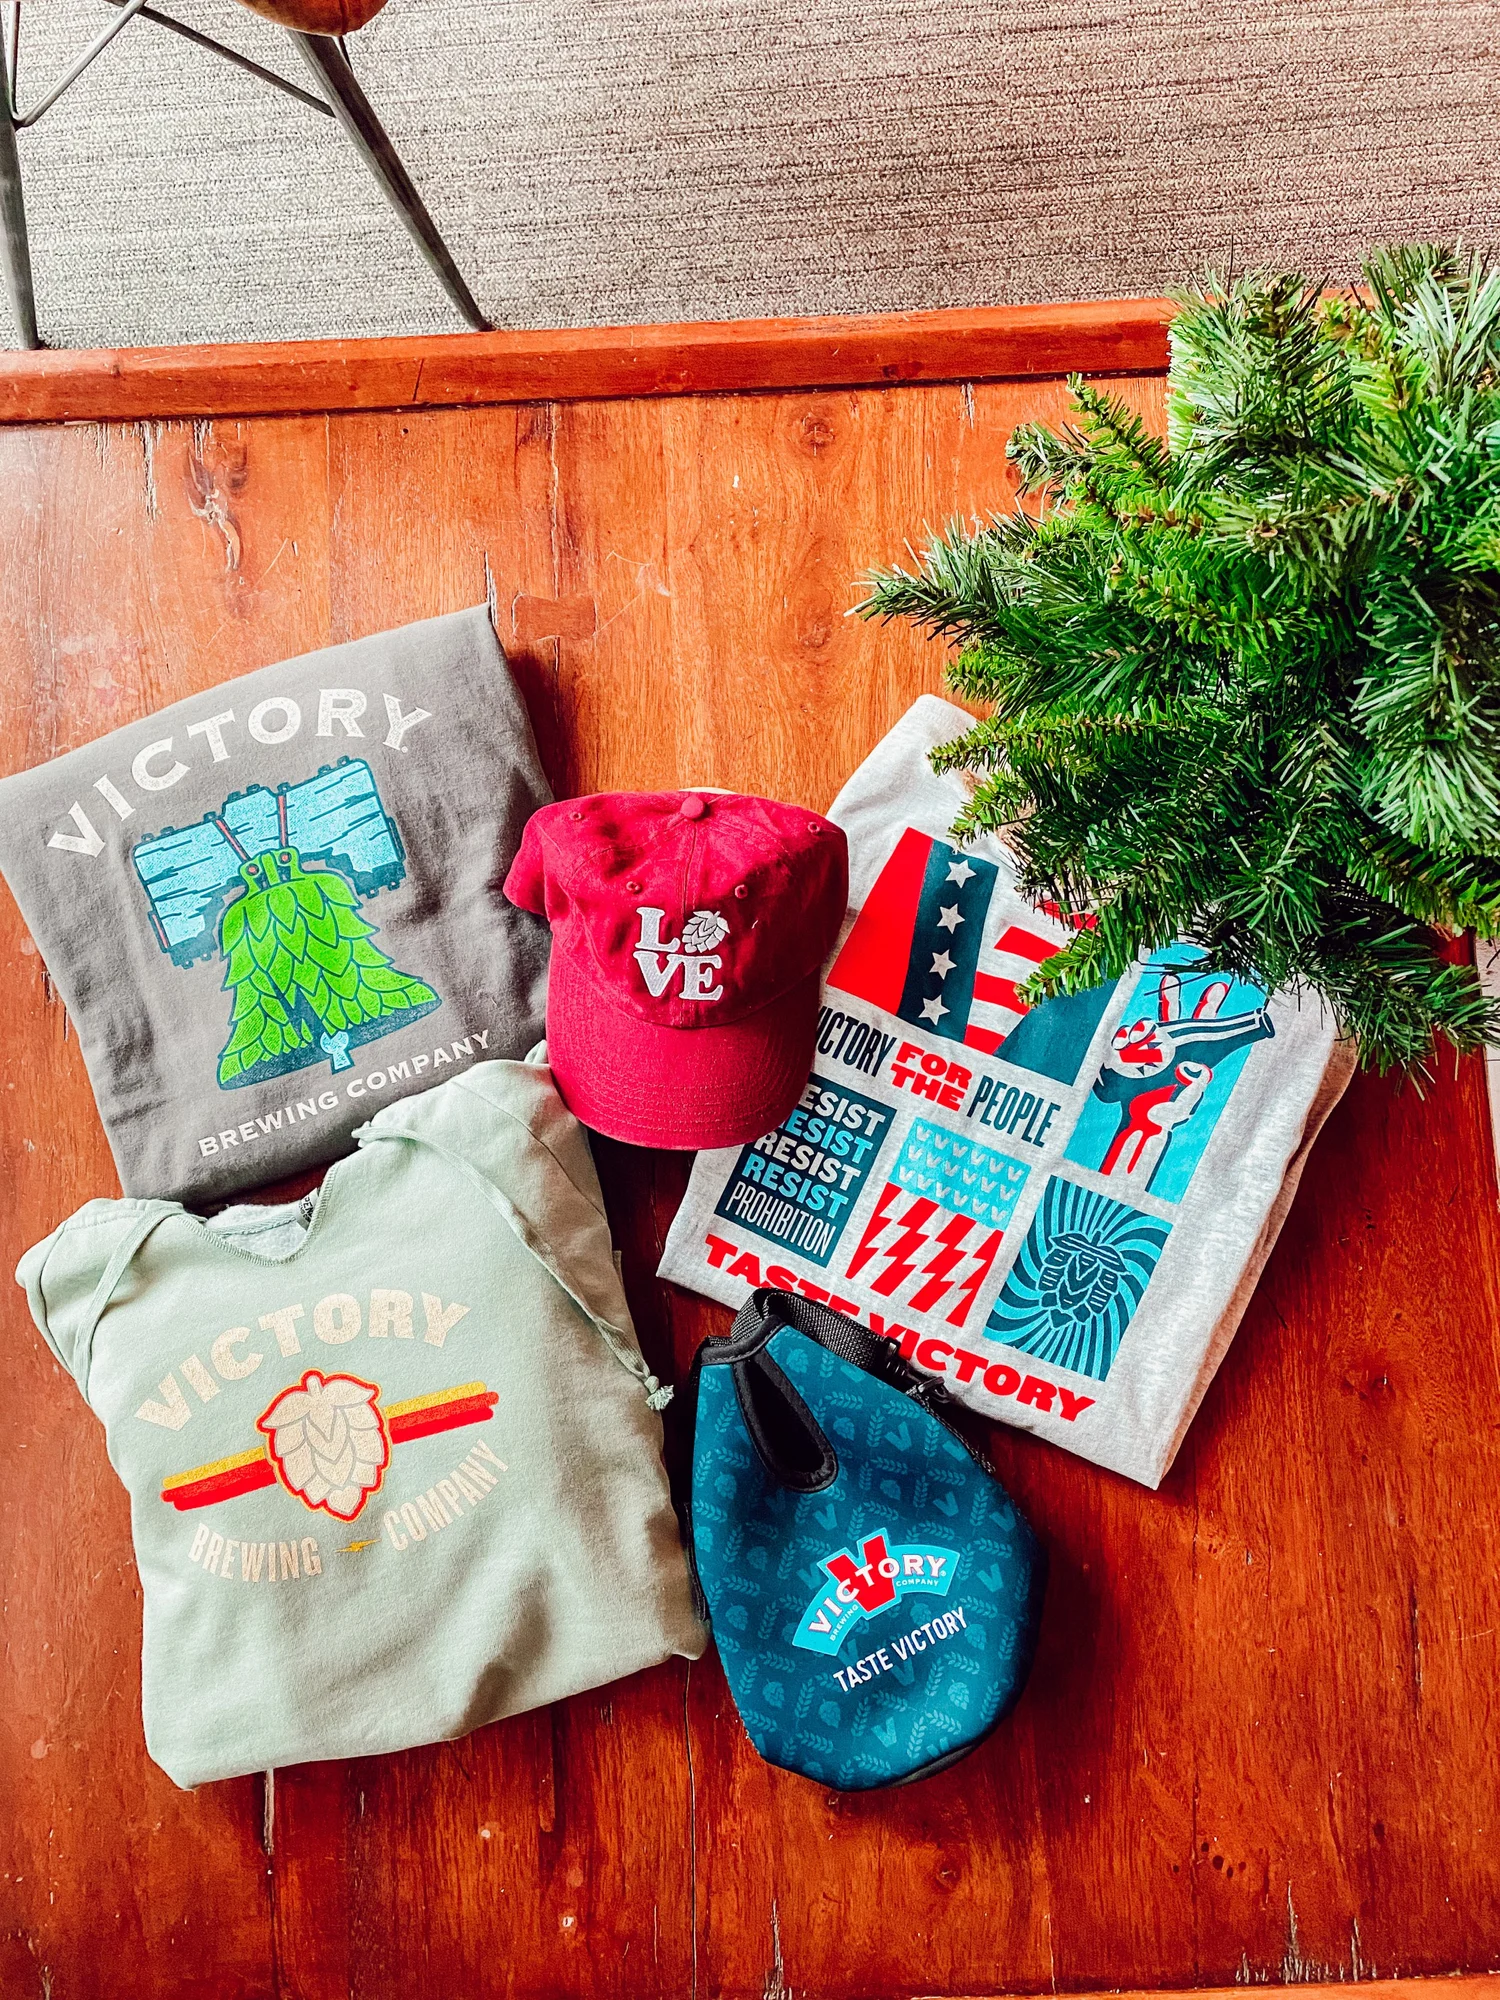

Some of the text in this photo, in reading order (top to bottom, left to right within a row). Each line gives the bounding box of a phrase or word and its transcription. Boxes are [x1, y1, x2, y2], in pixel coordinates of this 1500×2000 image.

[47, 688, 432, 858] VICTORY
[197, 1029, 491, 1158] BREWING COMPANY
[798, 1084, 886, 1137] ESIST
[816, 1006, 1061, 1148] ICTORY FOR PEOPLE
[890, 1063, 965, 1112] THE
[754, 1130, 861, 1190] RESIST
[779, 1109, 874, 1164] ESIST
[725, 1183, 836, 1258] PROHIBITION
[741, 1154, 850, 1219] RESIST
[134, 1288, 472, 1432] VICTORY
[187, 1439, 509, 1582] BREWING COMPANY
[829, 1578, 939, 1642] BREWING COMPANY
[833, 1606, 967, 1692] TASTE VICTORY
